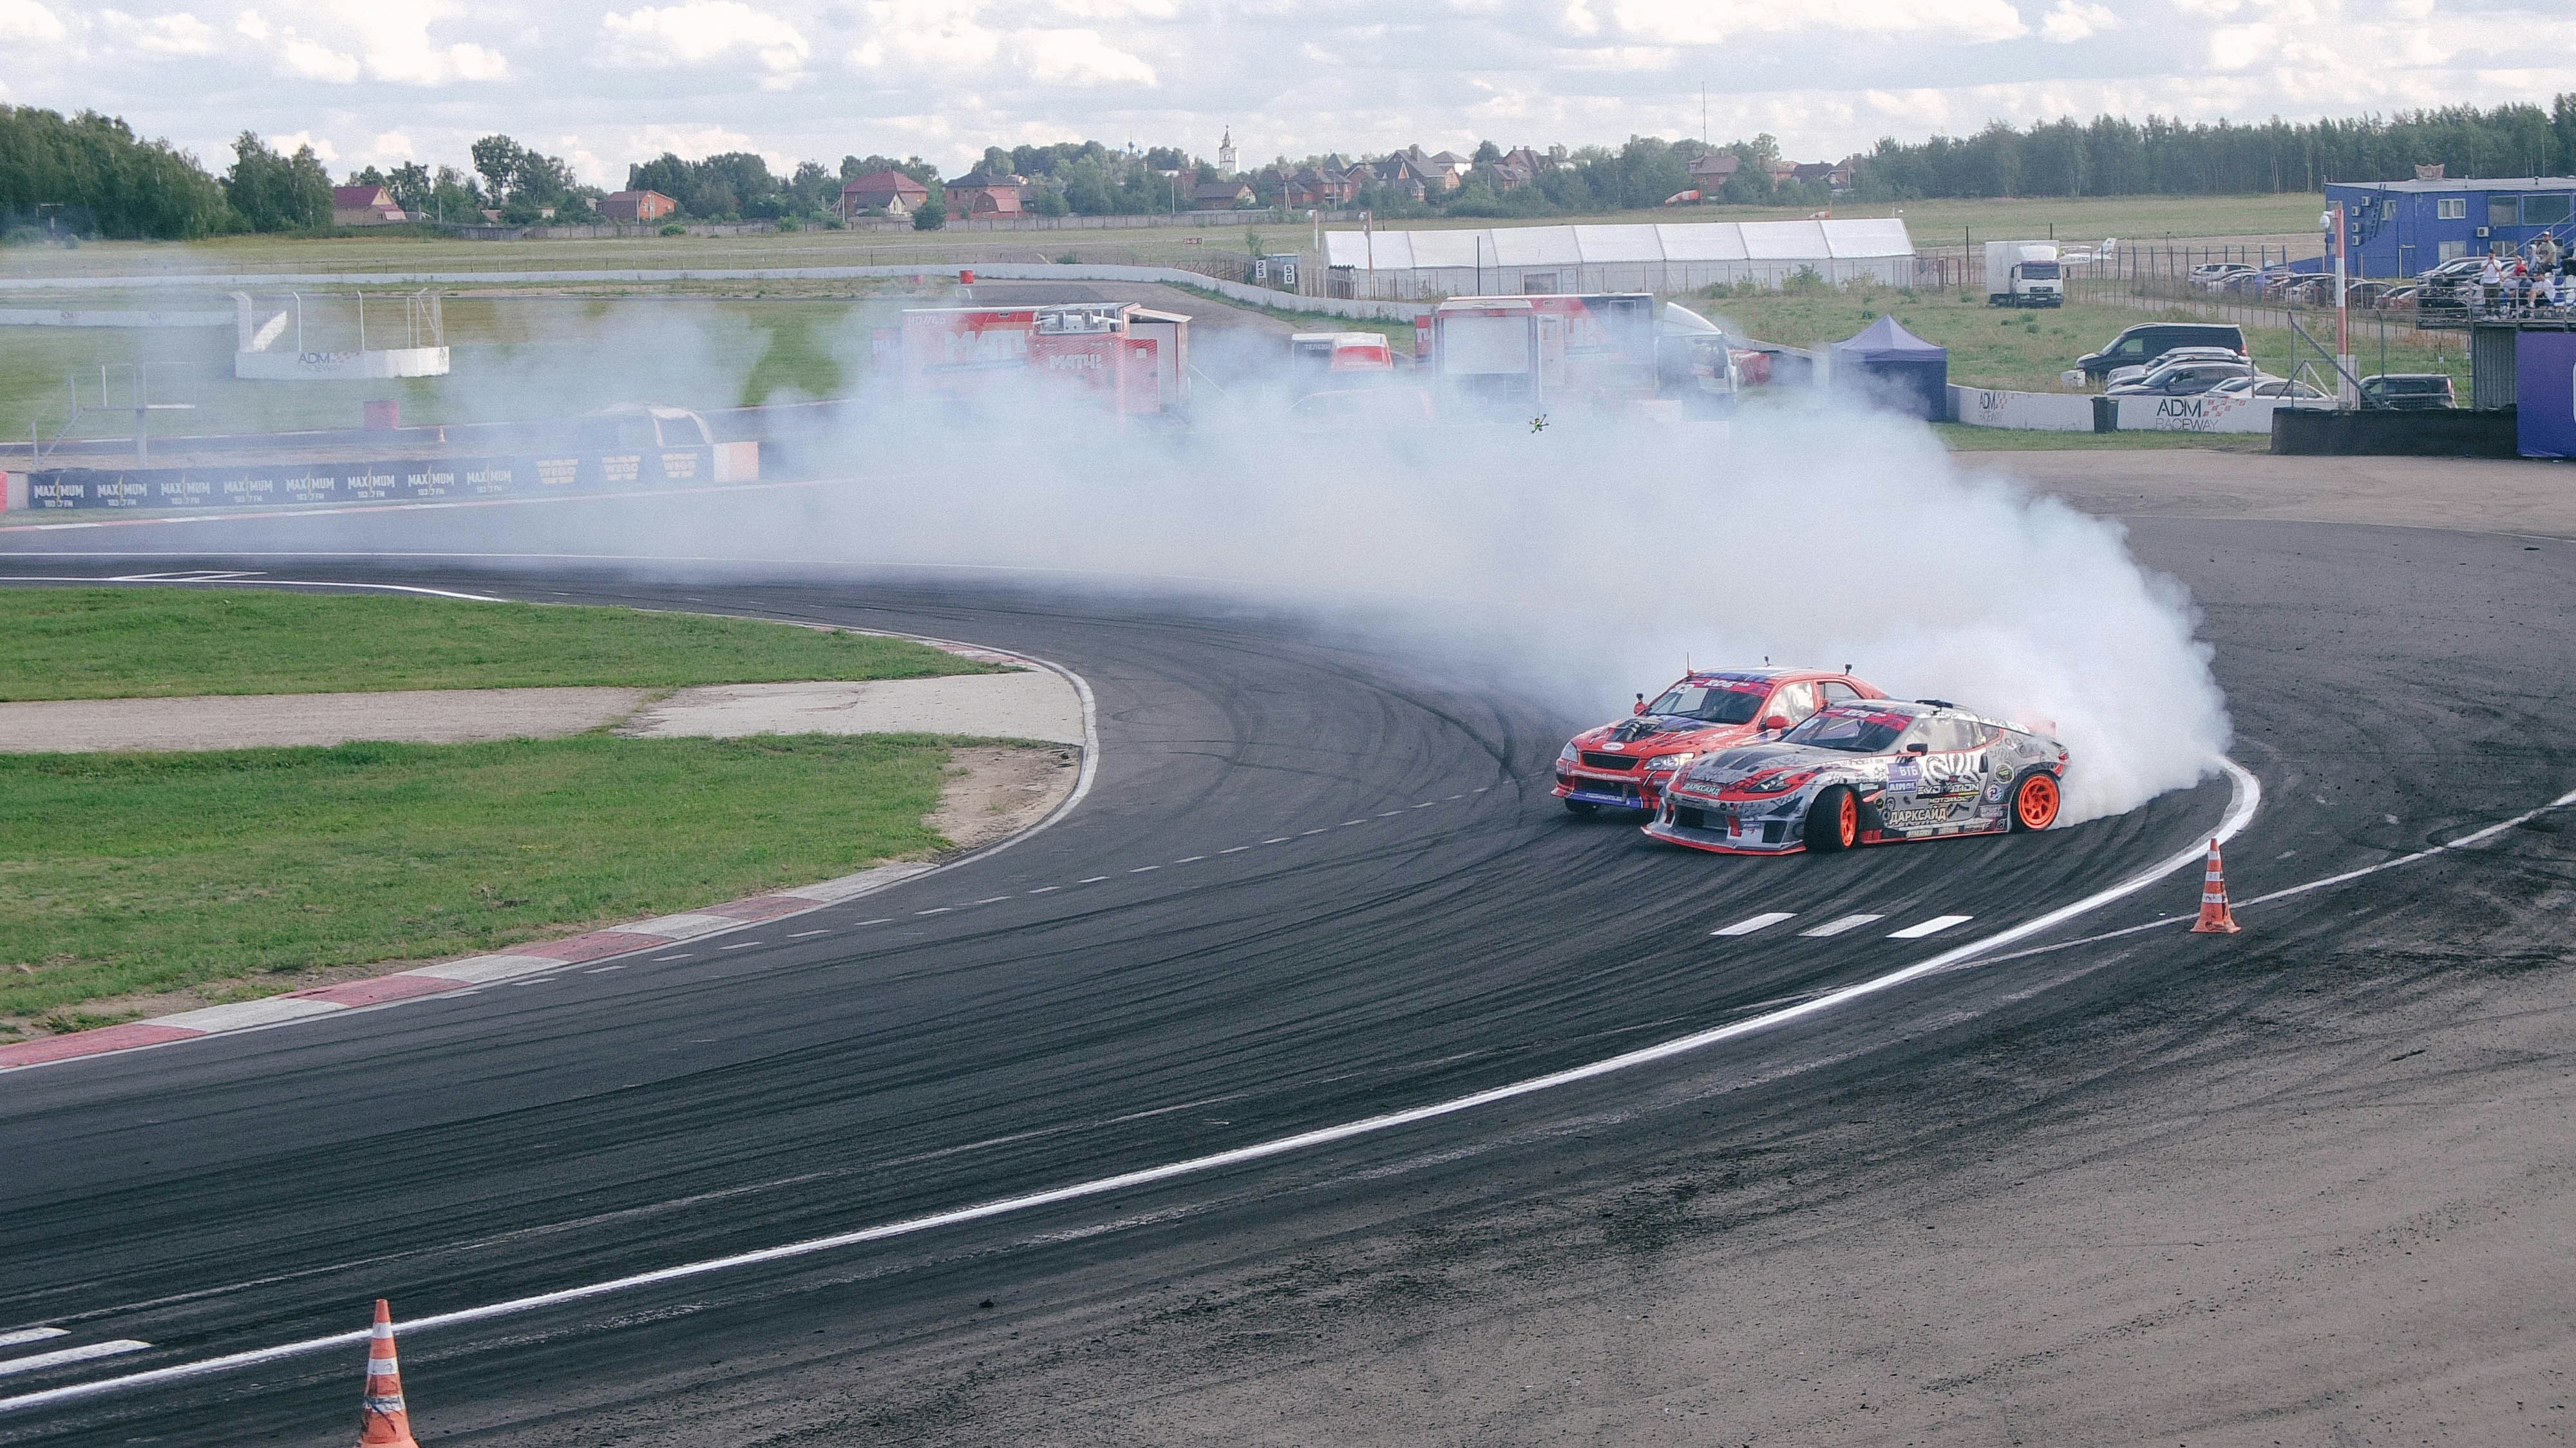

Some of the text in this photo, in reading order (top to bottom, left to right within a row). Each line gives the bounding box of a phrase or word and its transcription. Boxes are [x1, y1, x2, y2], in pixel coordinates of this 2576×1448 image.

[298, 352, 330, 364] ADM
[1979, 392, 1996, 410] ADM
[2156, 399, 2201, 417] ADM
[2155, 418, 2219, 431] RACEWAY
[1899, 765, 1918, 776] ВТБ
[1889, 805, 1948, 825] ДАРКСАЙД
